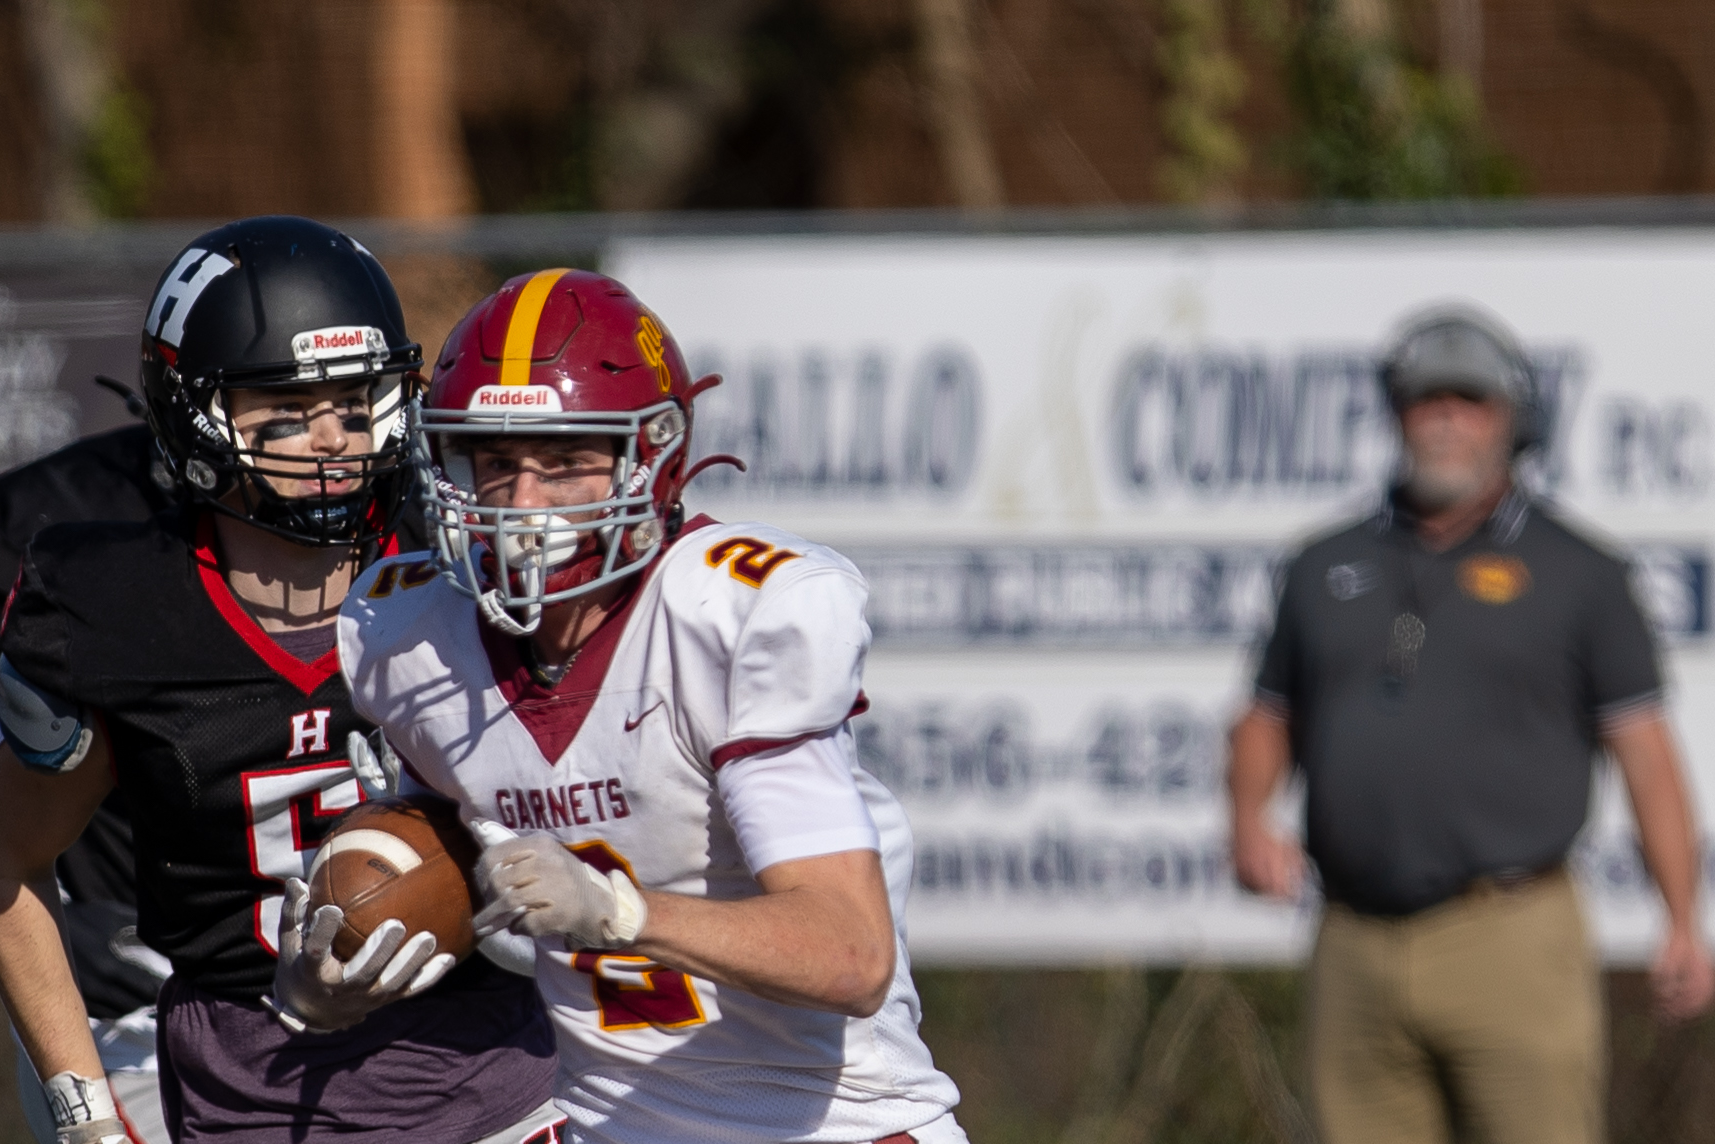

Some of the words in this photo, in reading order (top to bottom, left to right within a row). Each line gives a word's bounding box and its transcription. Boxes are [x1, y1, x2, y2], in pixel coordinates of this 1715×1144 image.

[313, 329, 364, 351] Riddell
[479, 390, 548, 406] Riddell
[704, 535, 803, 590] 2
[287, 708, 331, 759] H
[495, 777, 632, 831] GARNETS
[367, 858, 399, 879] GST
